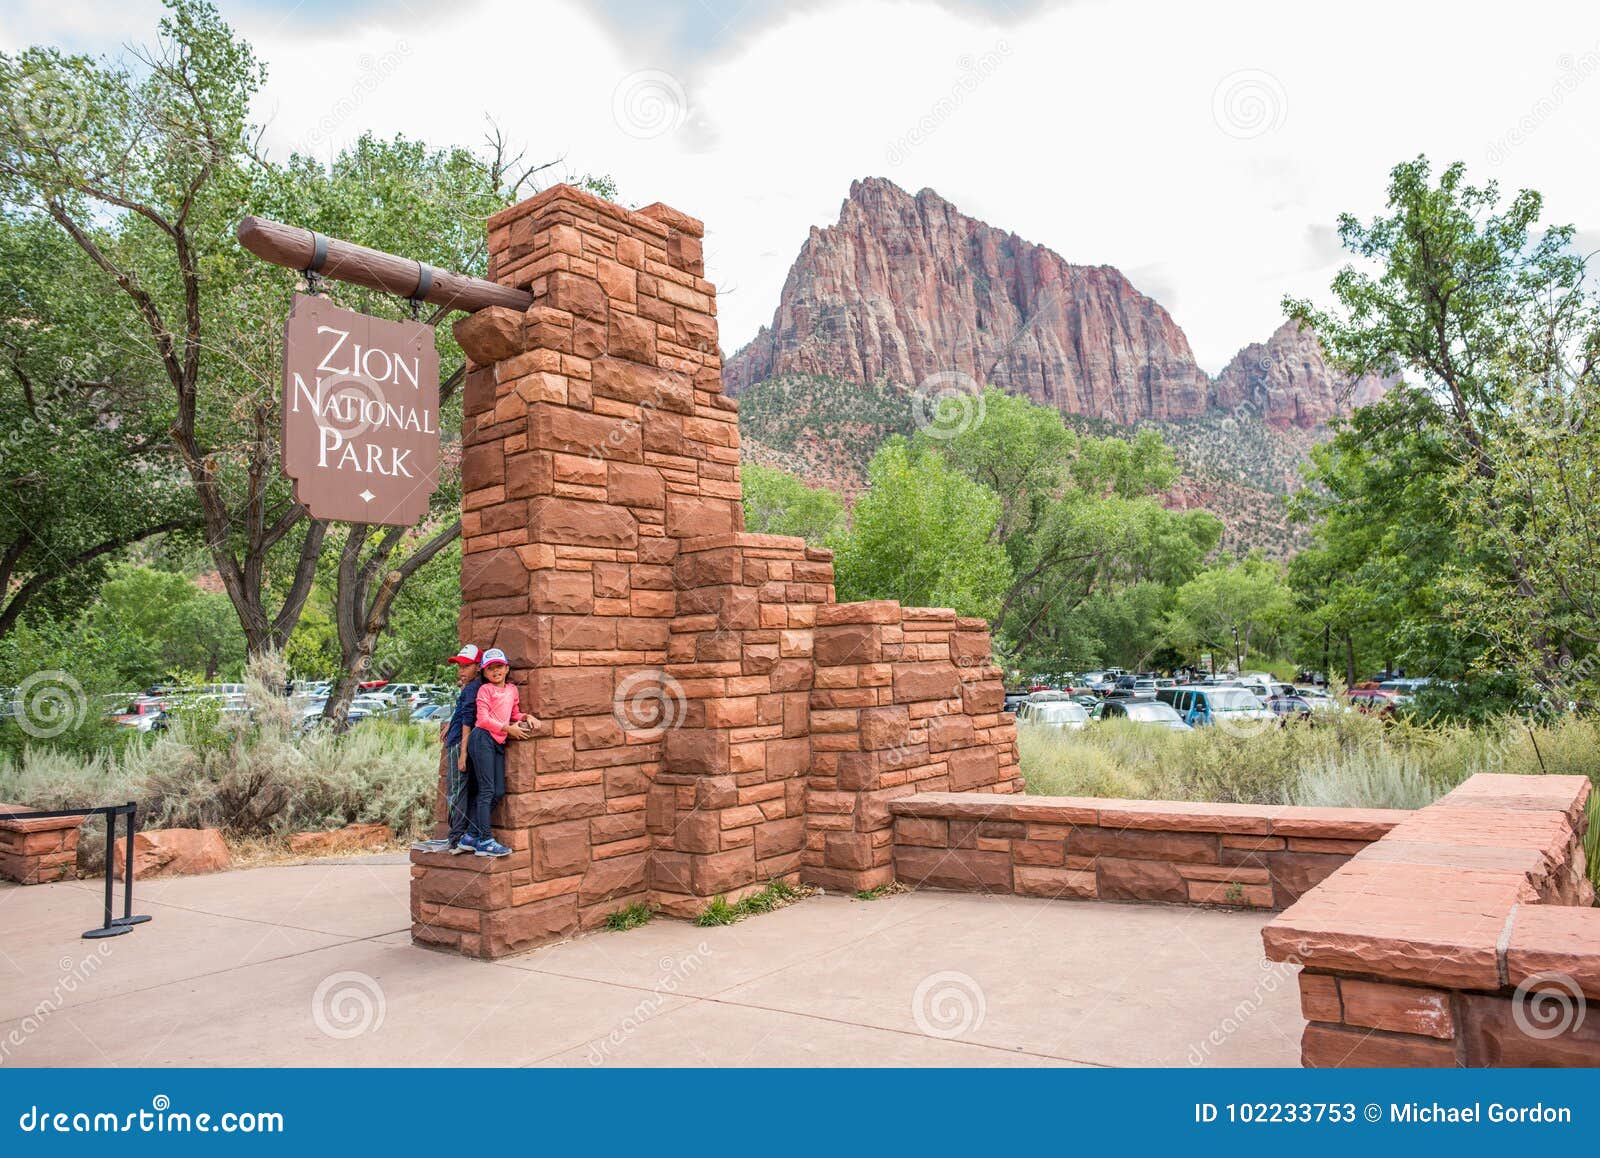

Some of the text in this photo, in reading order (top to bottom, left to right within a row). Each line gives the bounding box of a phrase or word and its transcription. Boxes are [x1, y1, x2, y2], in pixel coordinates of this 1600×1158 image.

[317, 326, 419, 390] ZION
[292, 372, 435, 434] NATIONAL
[317, 426, 414, 478] PARK
